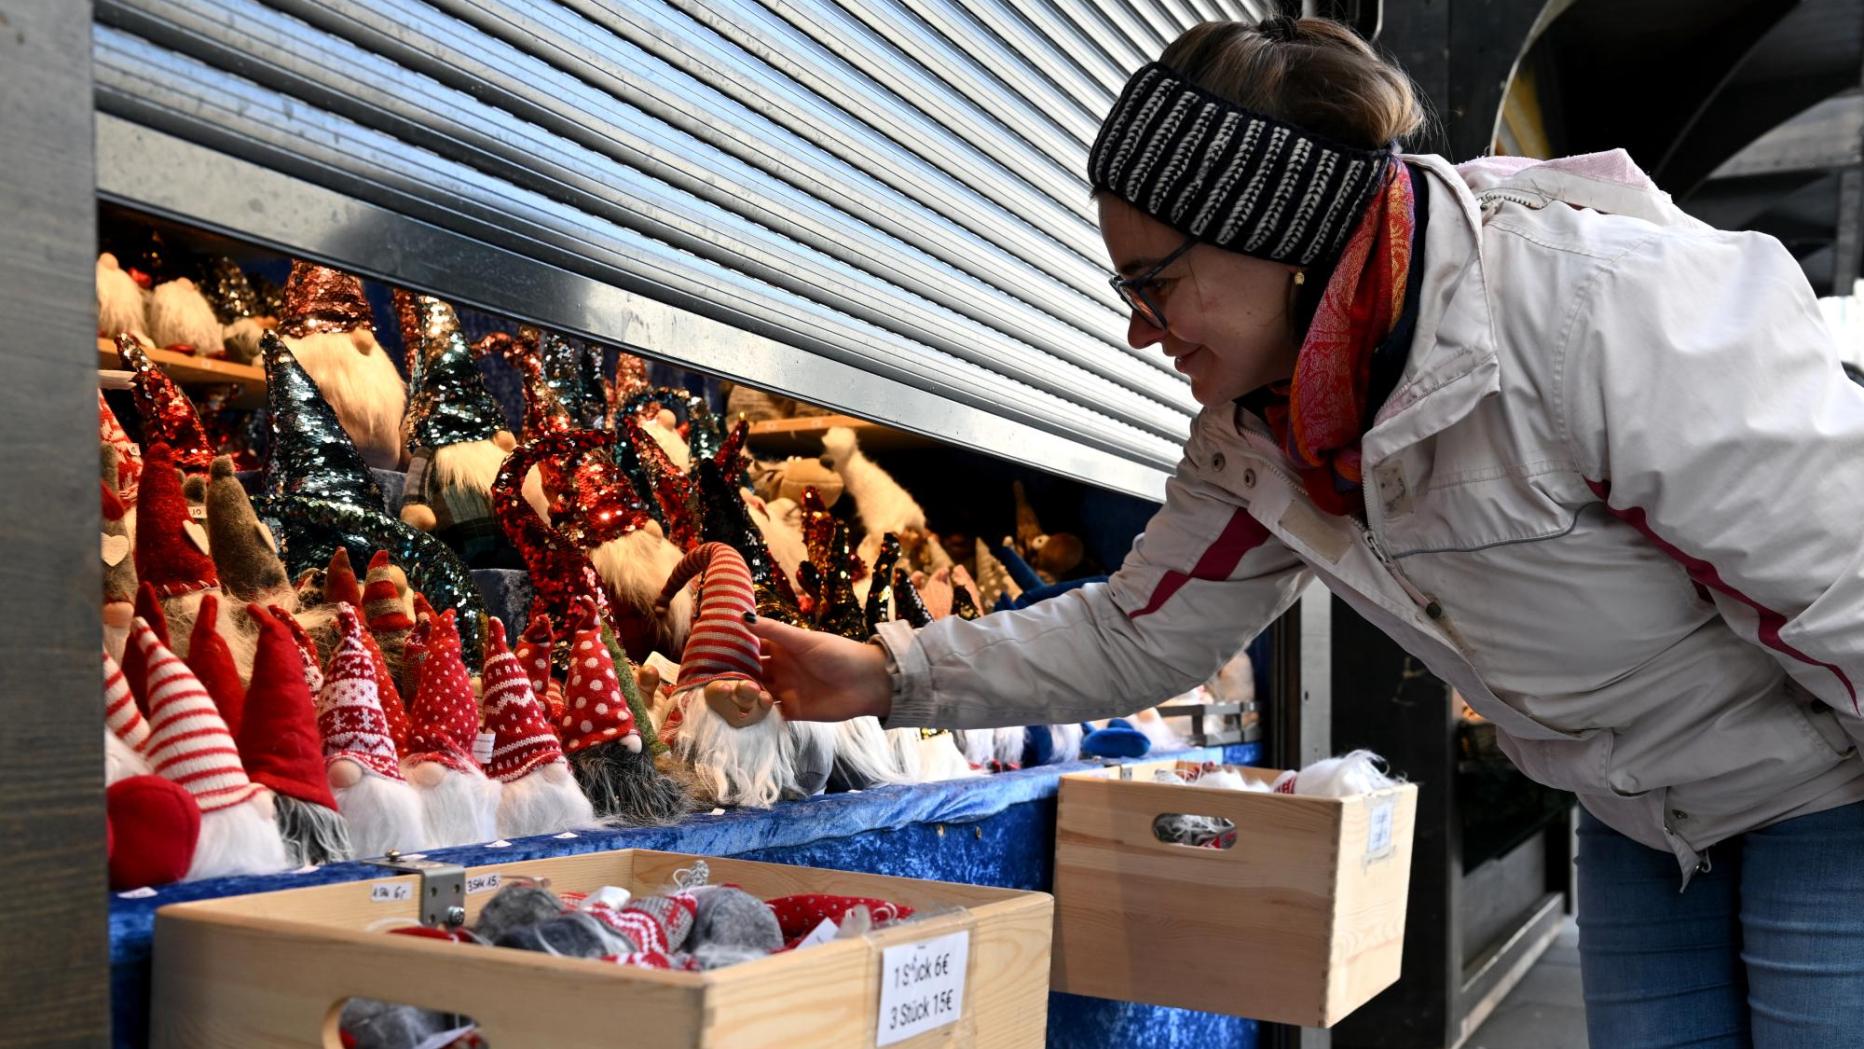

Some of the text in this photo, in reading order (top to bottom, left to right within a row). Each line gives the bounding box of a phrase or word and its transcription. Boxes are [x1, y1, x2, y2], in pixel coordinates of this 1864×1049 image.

[935, 953, 950, 977] 6€
[890, 988, 954, 1030] 3 Stück 15€
